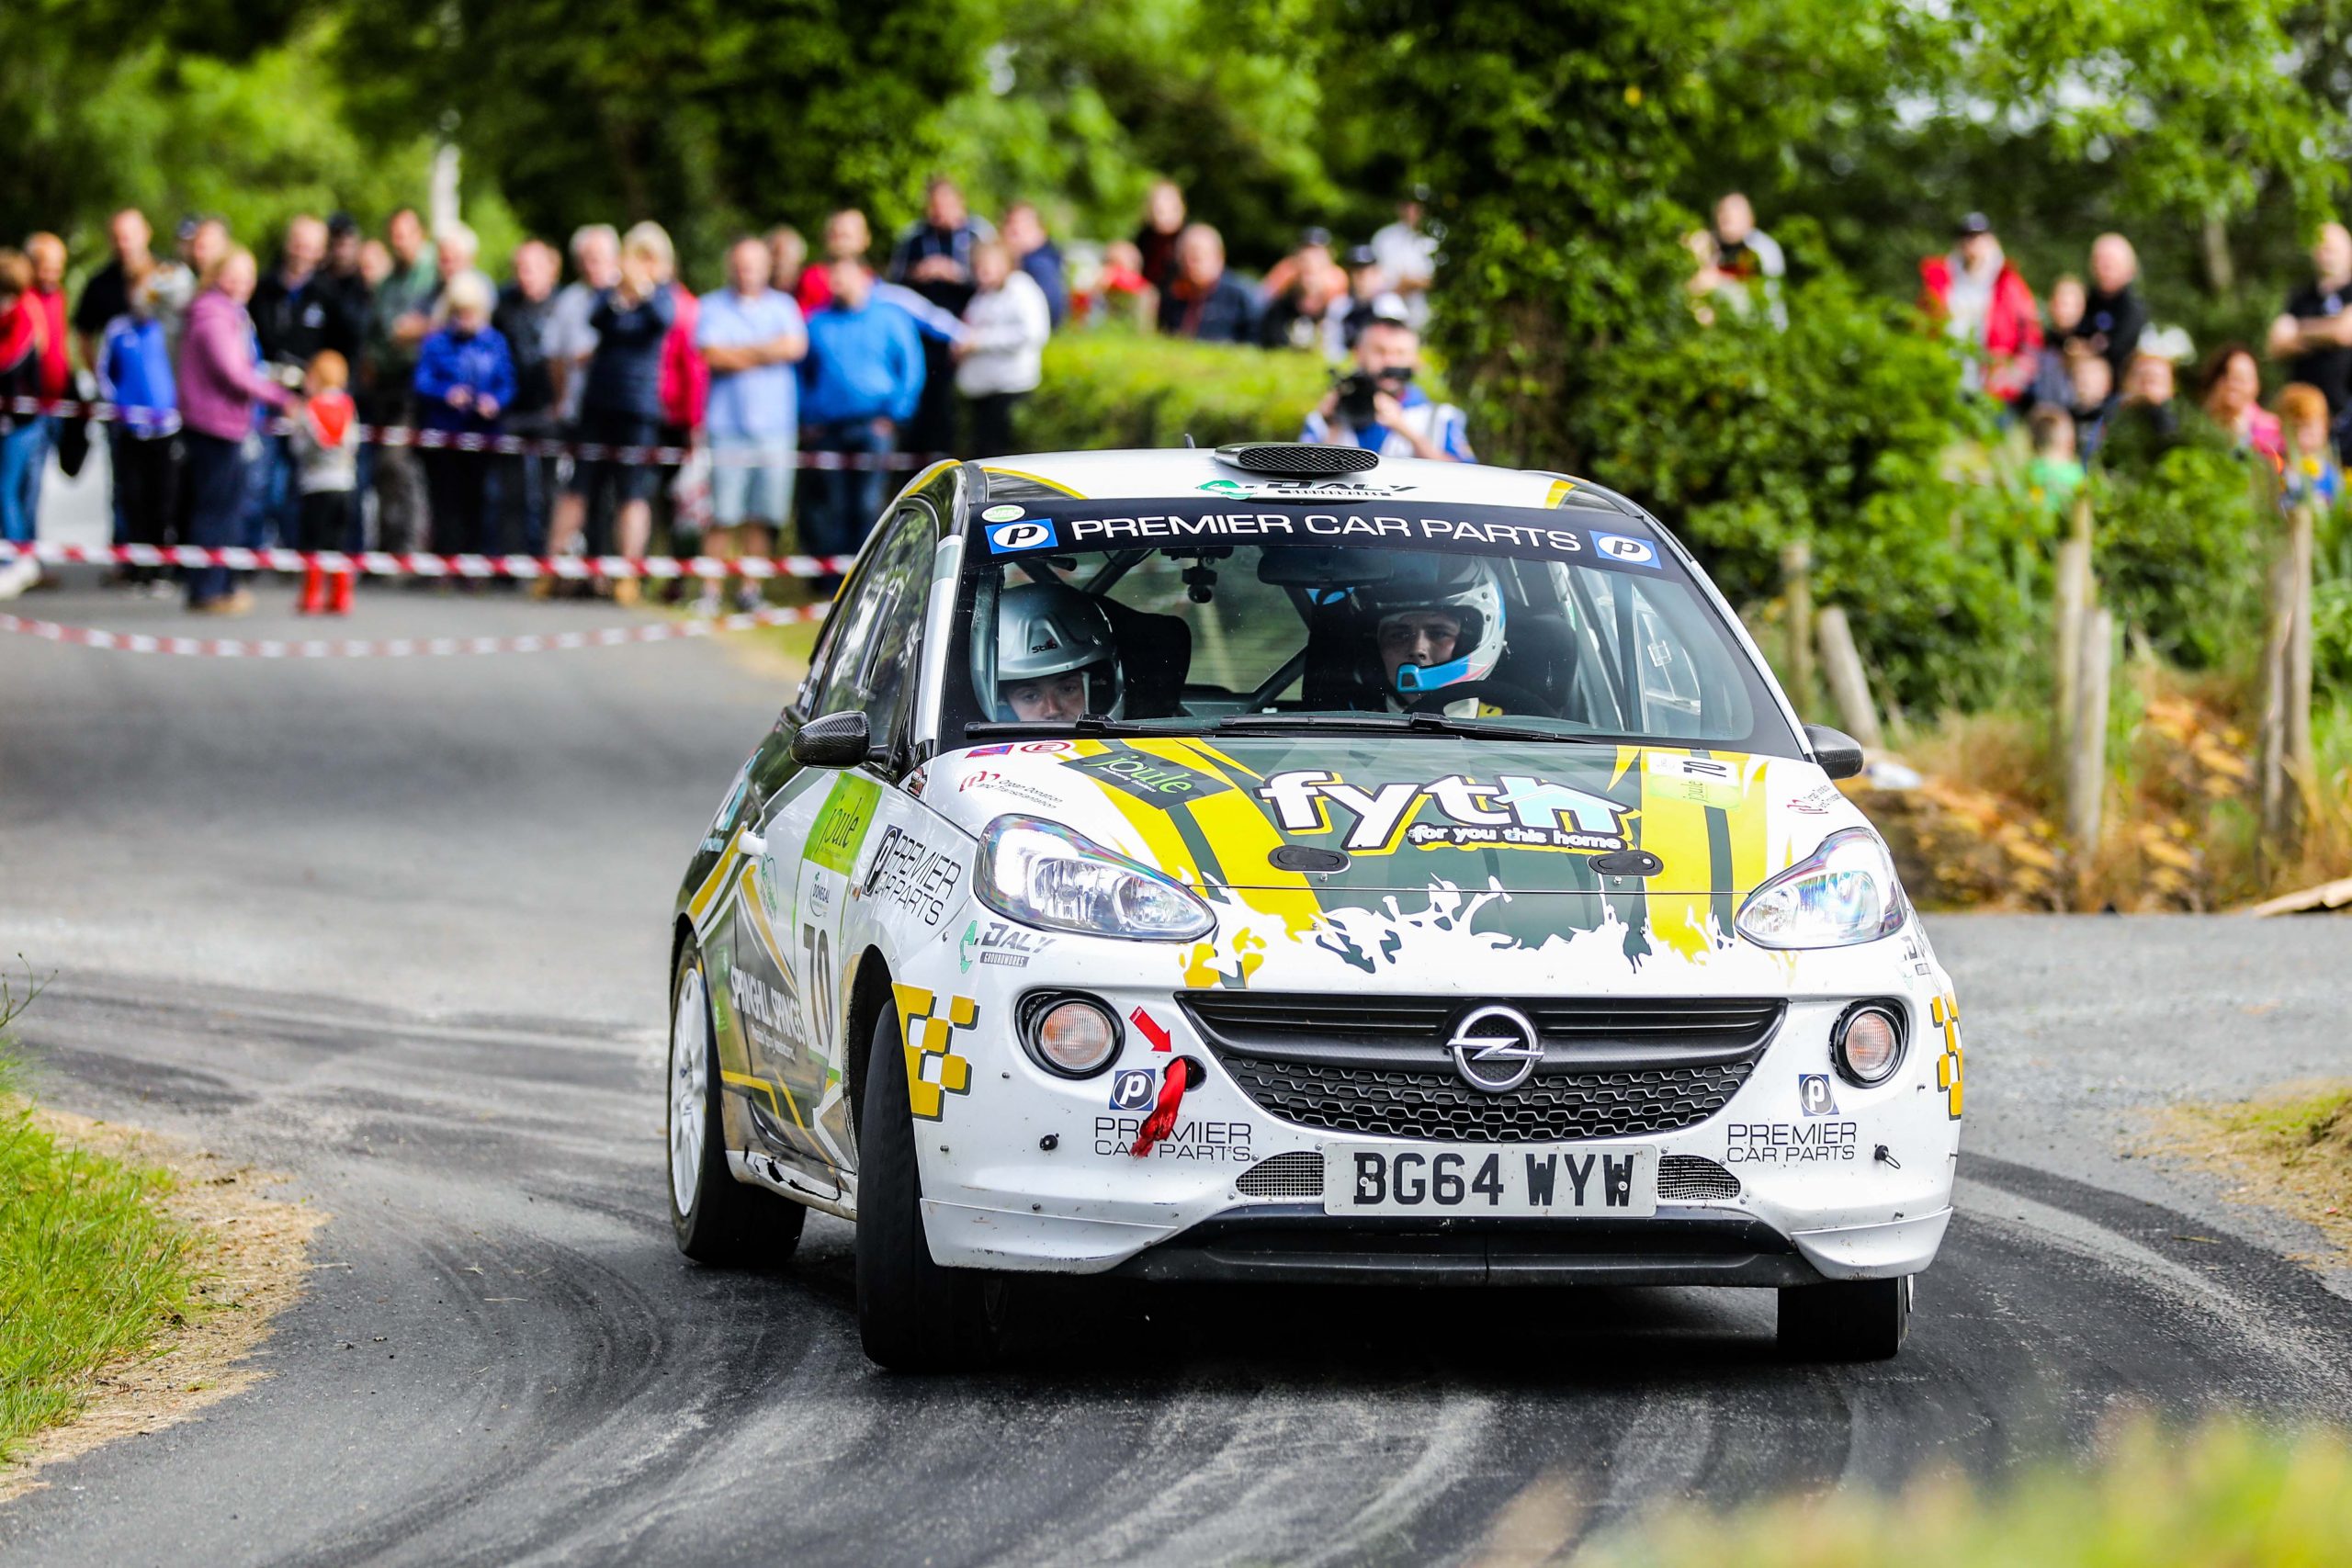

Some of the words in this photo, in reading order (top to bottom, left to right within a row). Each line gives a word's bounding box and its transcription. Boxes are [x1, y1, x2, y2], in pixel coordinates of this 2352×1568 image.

[1266, 479, 1419, 492] DALY
[1070, 513, 1294, 541] PREMIER
[1304, 513, 1412, 537] CAR
[1419, 519, 1582, 552] PARTS
[1082, 754, 1193, 794] joule
[1682, 760, 1727, 777] 70
[814, 794, 864, 854] joule
[1411, 825, 1448, 842] for
[1453, 827, 1498, 843] you
[1503, 826, 1547, 843] this
[1553, 829, 1622, 849] home
[887, 834, 962, 900] PREMIER
[888, 878, 944, 926] PARTS
[980, 921, 1057, 953] DALY
[803, 922, 833, 1056] 70
[1095, 1116, 1251, 1145] PRMIER
[1727, 1122, 1858, 1145] PREMIER
[1094, 1139, 1148, 1158] CA
[1159, 1144, 1251, 1162] PARTS
[1726, 1146, 1777, 1163] CAR
[1785, 1145, 1856, 1162] PARTS
[1352, 1151, 1505, 1206] BG64
[1524, 1153, 1635, 1208] WYW
